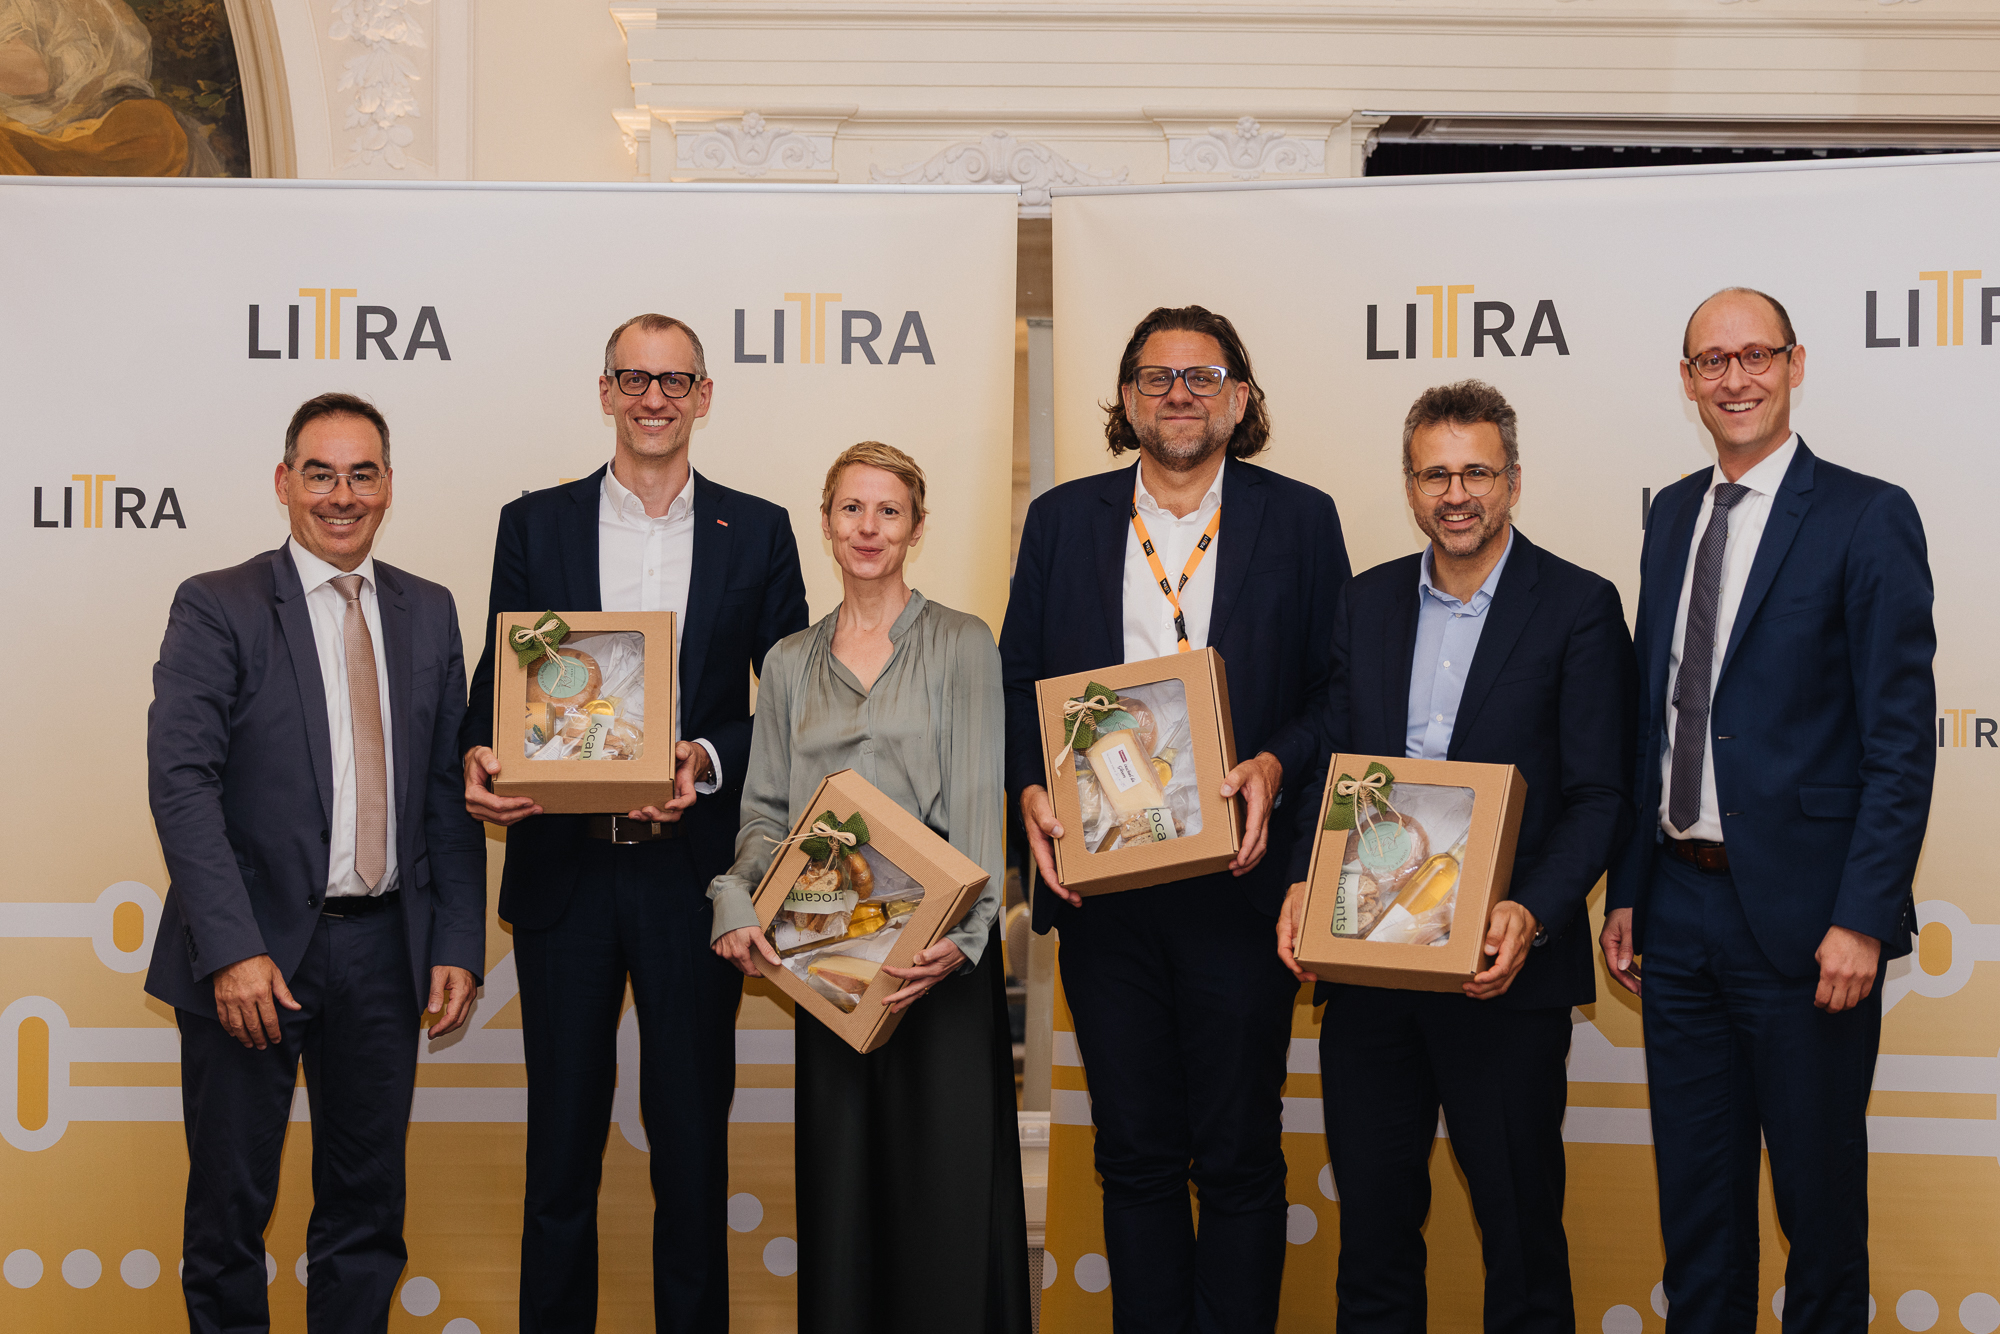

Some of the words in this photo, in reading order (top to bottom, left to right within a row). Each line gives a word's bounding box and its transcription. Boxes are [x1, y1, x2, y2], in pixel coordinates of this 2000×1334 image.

[248, 287, 452, 361] LITRA
[733, 292, 936, 366] LITRA
[1366, 284, 1570, 360] LITRA
[1865, 269, 2000, 348] LIT
[33, 473, 187, 529] LITRA
[1938, 708, 1999, 748] ITR
